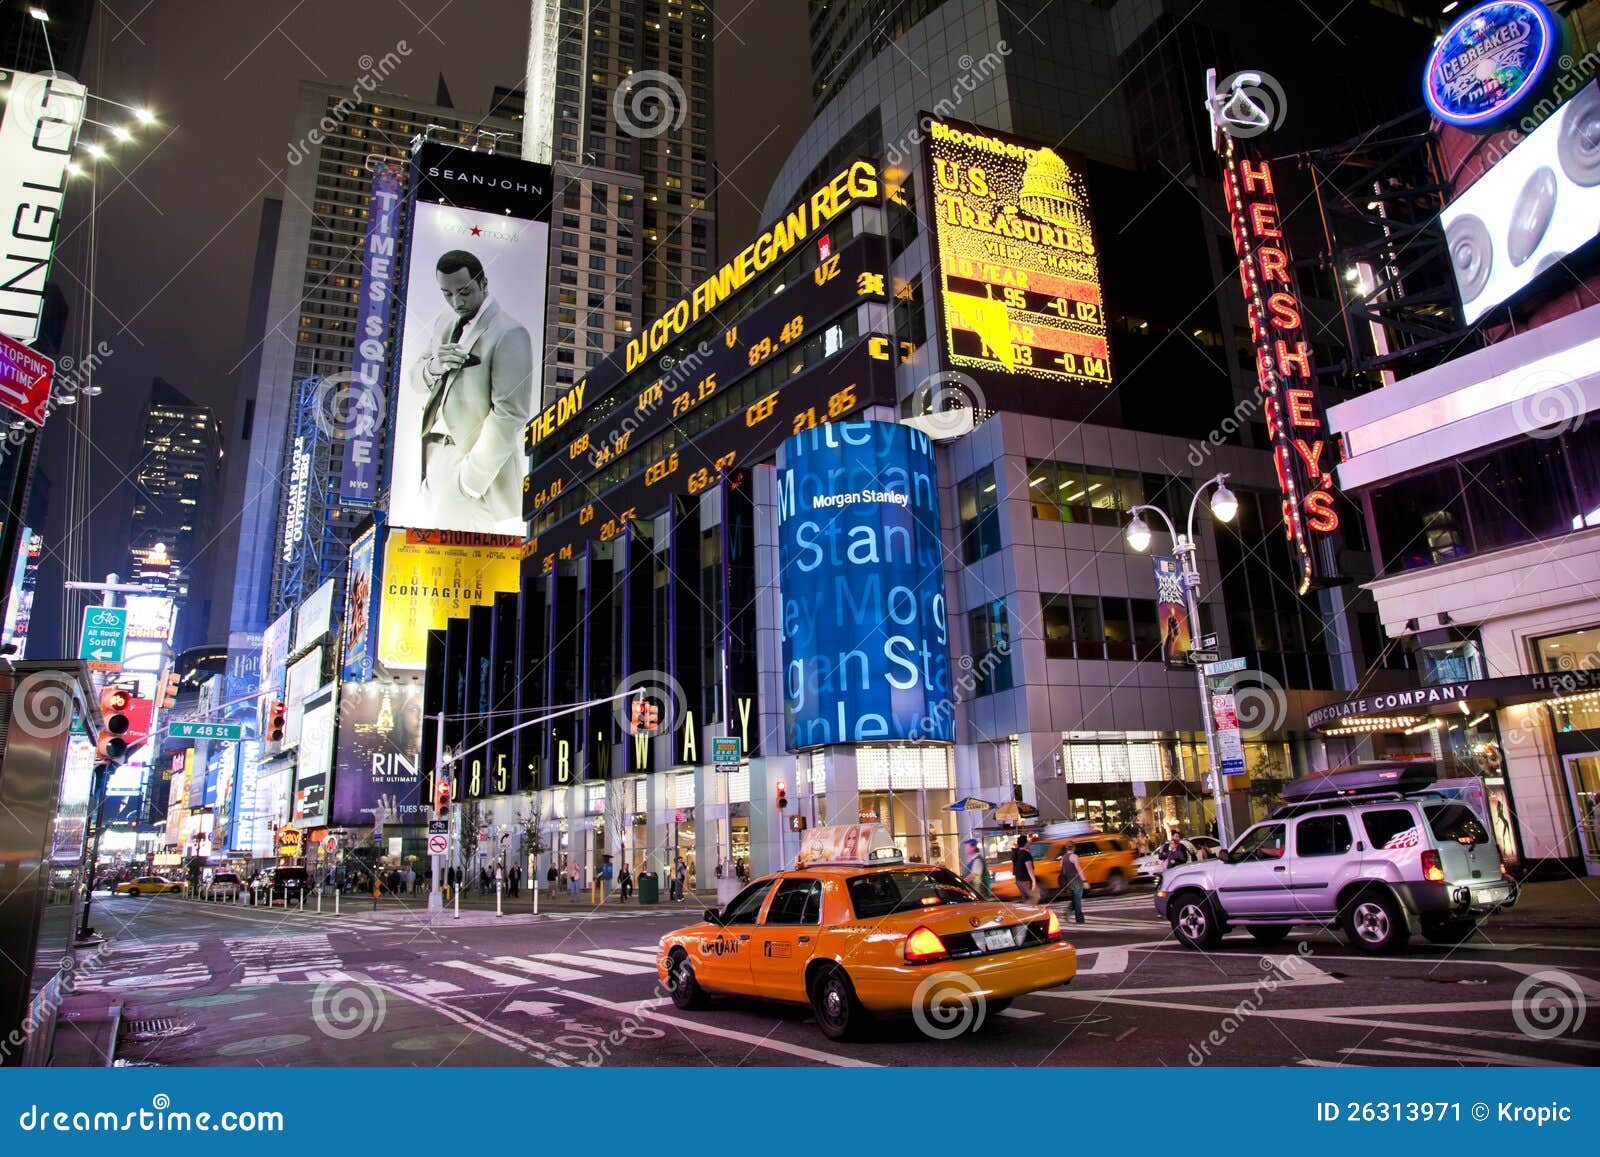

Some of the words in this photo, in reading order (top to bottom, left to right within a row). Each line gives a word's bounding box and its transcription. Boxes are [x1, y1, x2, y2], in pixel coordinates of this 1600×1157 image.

[369, 191, 398, 302] TIMES
[530, 403, 556, 446] THE
[557, 379, 587, 427] DAY
[626, 328, 648, 373] DJ
[649, 300, 690, 352] CFO
[692, 202, 807, 322] FINNEGAN
[811, 161, 878, 231] REG
[1047, 301, 1099, 324] -0.02
[748, 315, 805, 367] 89.48
[1054, 355, 1105, 377] -0.04
[672, 373, 717, 418] 73.15
[283, 484, 299, 562] AMERICAN
[291, 435, 304, 482] EAGLE
[293, 452, 311, 541] OUTFITTERS
[813, 492, 861, 510] Morgan
[862, 489, 909, 508] Stanley
[389, 584, 483, 600] CONTAGION
[89, 638, 117, 647] South
[100, 630, 120, 638] Route
[1375, 684, 1471, 709] COMPANY
[182, 725, 194, 734] W
[196, 725, 213, 735] 48
[215, 726, 229, 737] St
[399, 805, 418, 813] TUES
